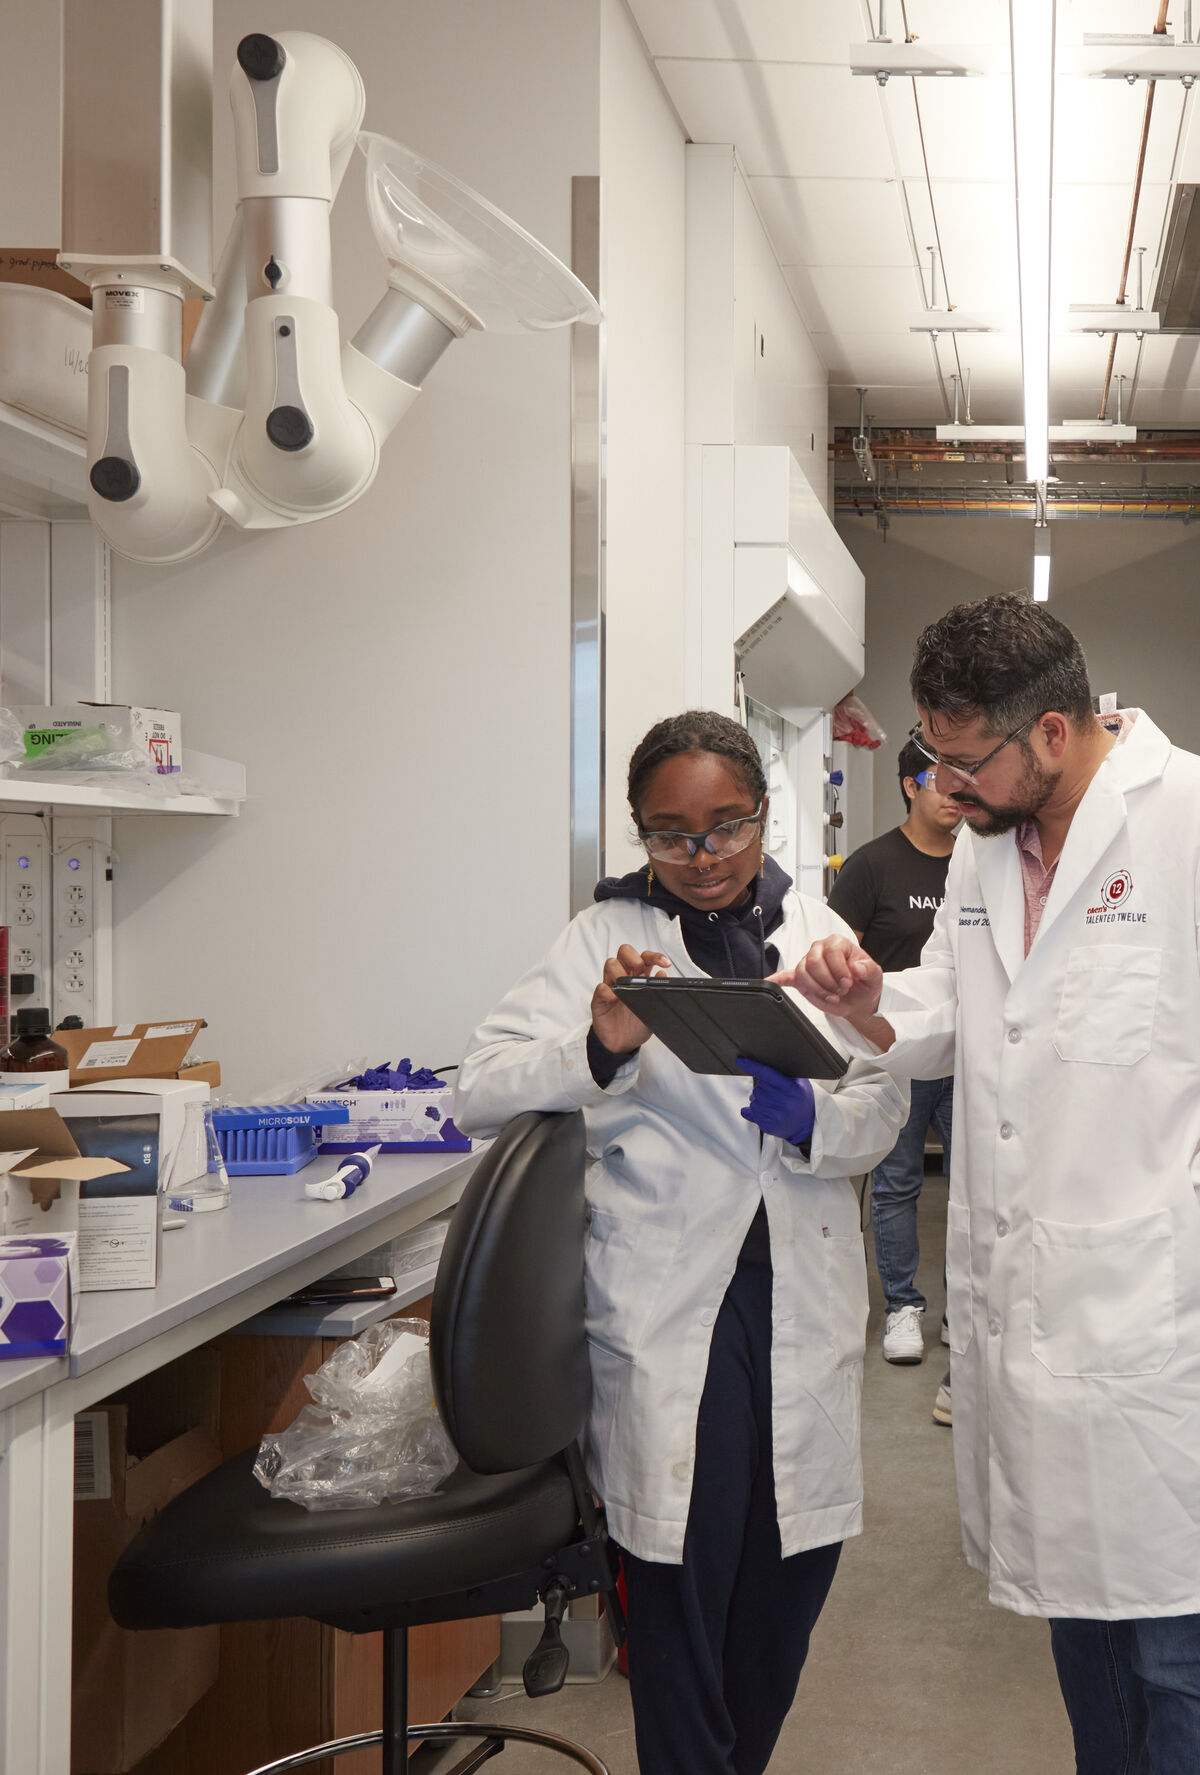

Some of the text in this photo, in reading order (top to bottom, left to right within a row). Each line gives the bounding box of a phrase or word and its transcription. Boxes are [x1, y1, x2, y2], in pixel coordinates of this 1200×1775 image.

[31, 734, 68, 745] ING
[1112, 883, 1122, 894] 12
[909, 895, 945, 909] NAU
[972, 918, 980, 926] of
[1086, 912, 1147, 924] TALENTED TWELVE
[258, 1115, 311, 1126] MICROSOLV
[143, 1153, 151, 1164] BD
